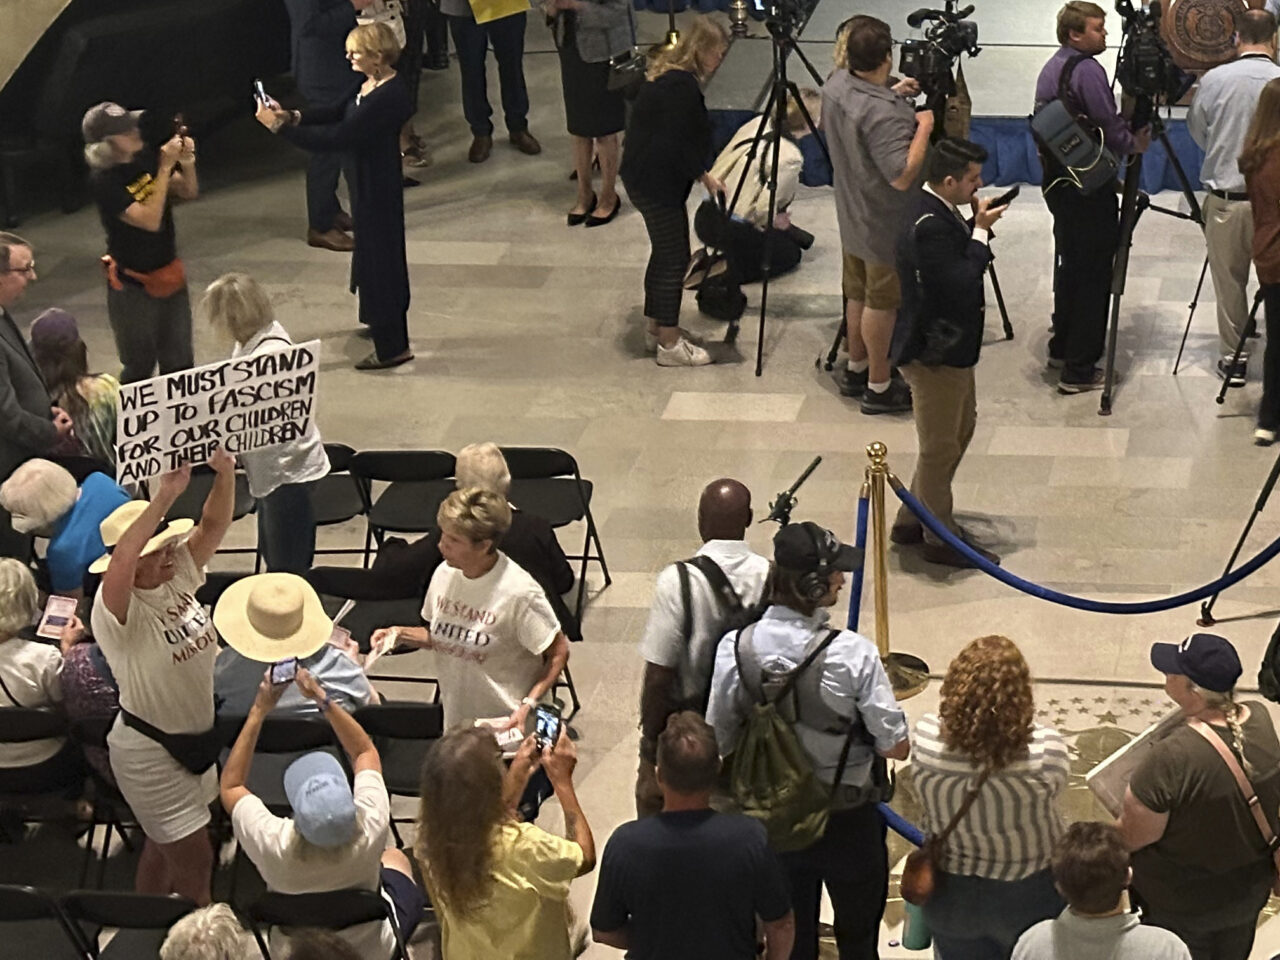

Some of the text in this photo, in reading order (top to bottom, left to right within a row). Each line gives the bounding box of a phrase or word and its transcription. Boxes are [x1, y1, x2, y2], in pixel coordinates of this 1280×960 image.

[119, 348, 314, 412] WE MUST STAND
[123, 371, 316, 437] UP TO FASCISM
[118, 397, 313, 463] FOR OUR CHILDREN
[119, 417, 310, 485] AND THEIR CHILDREN
